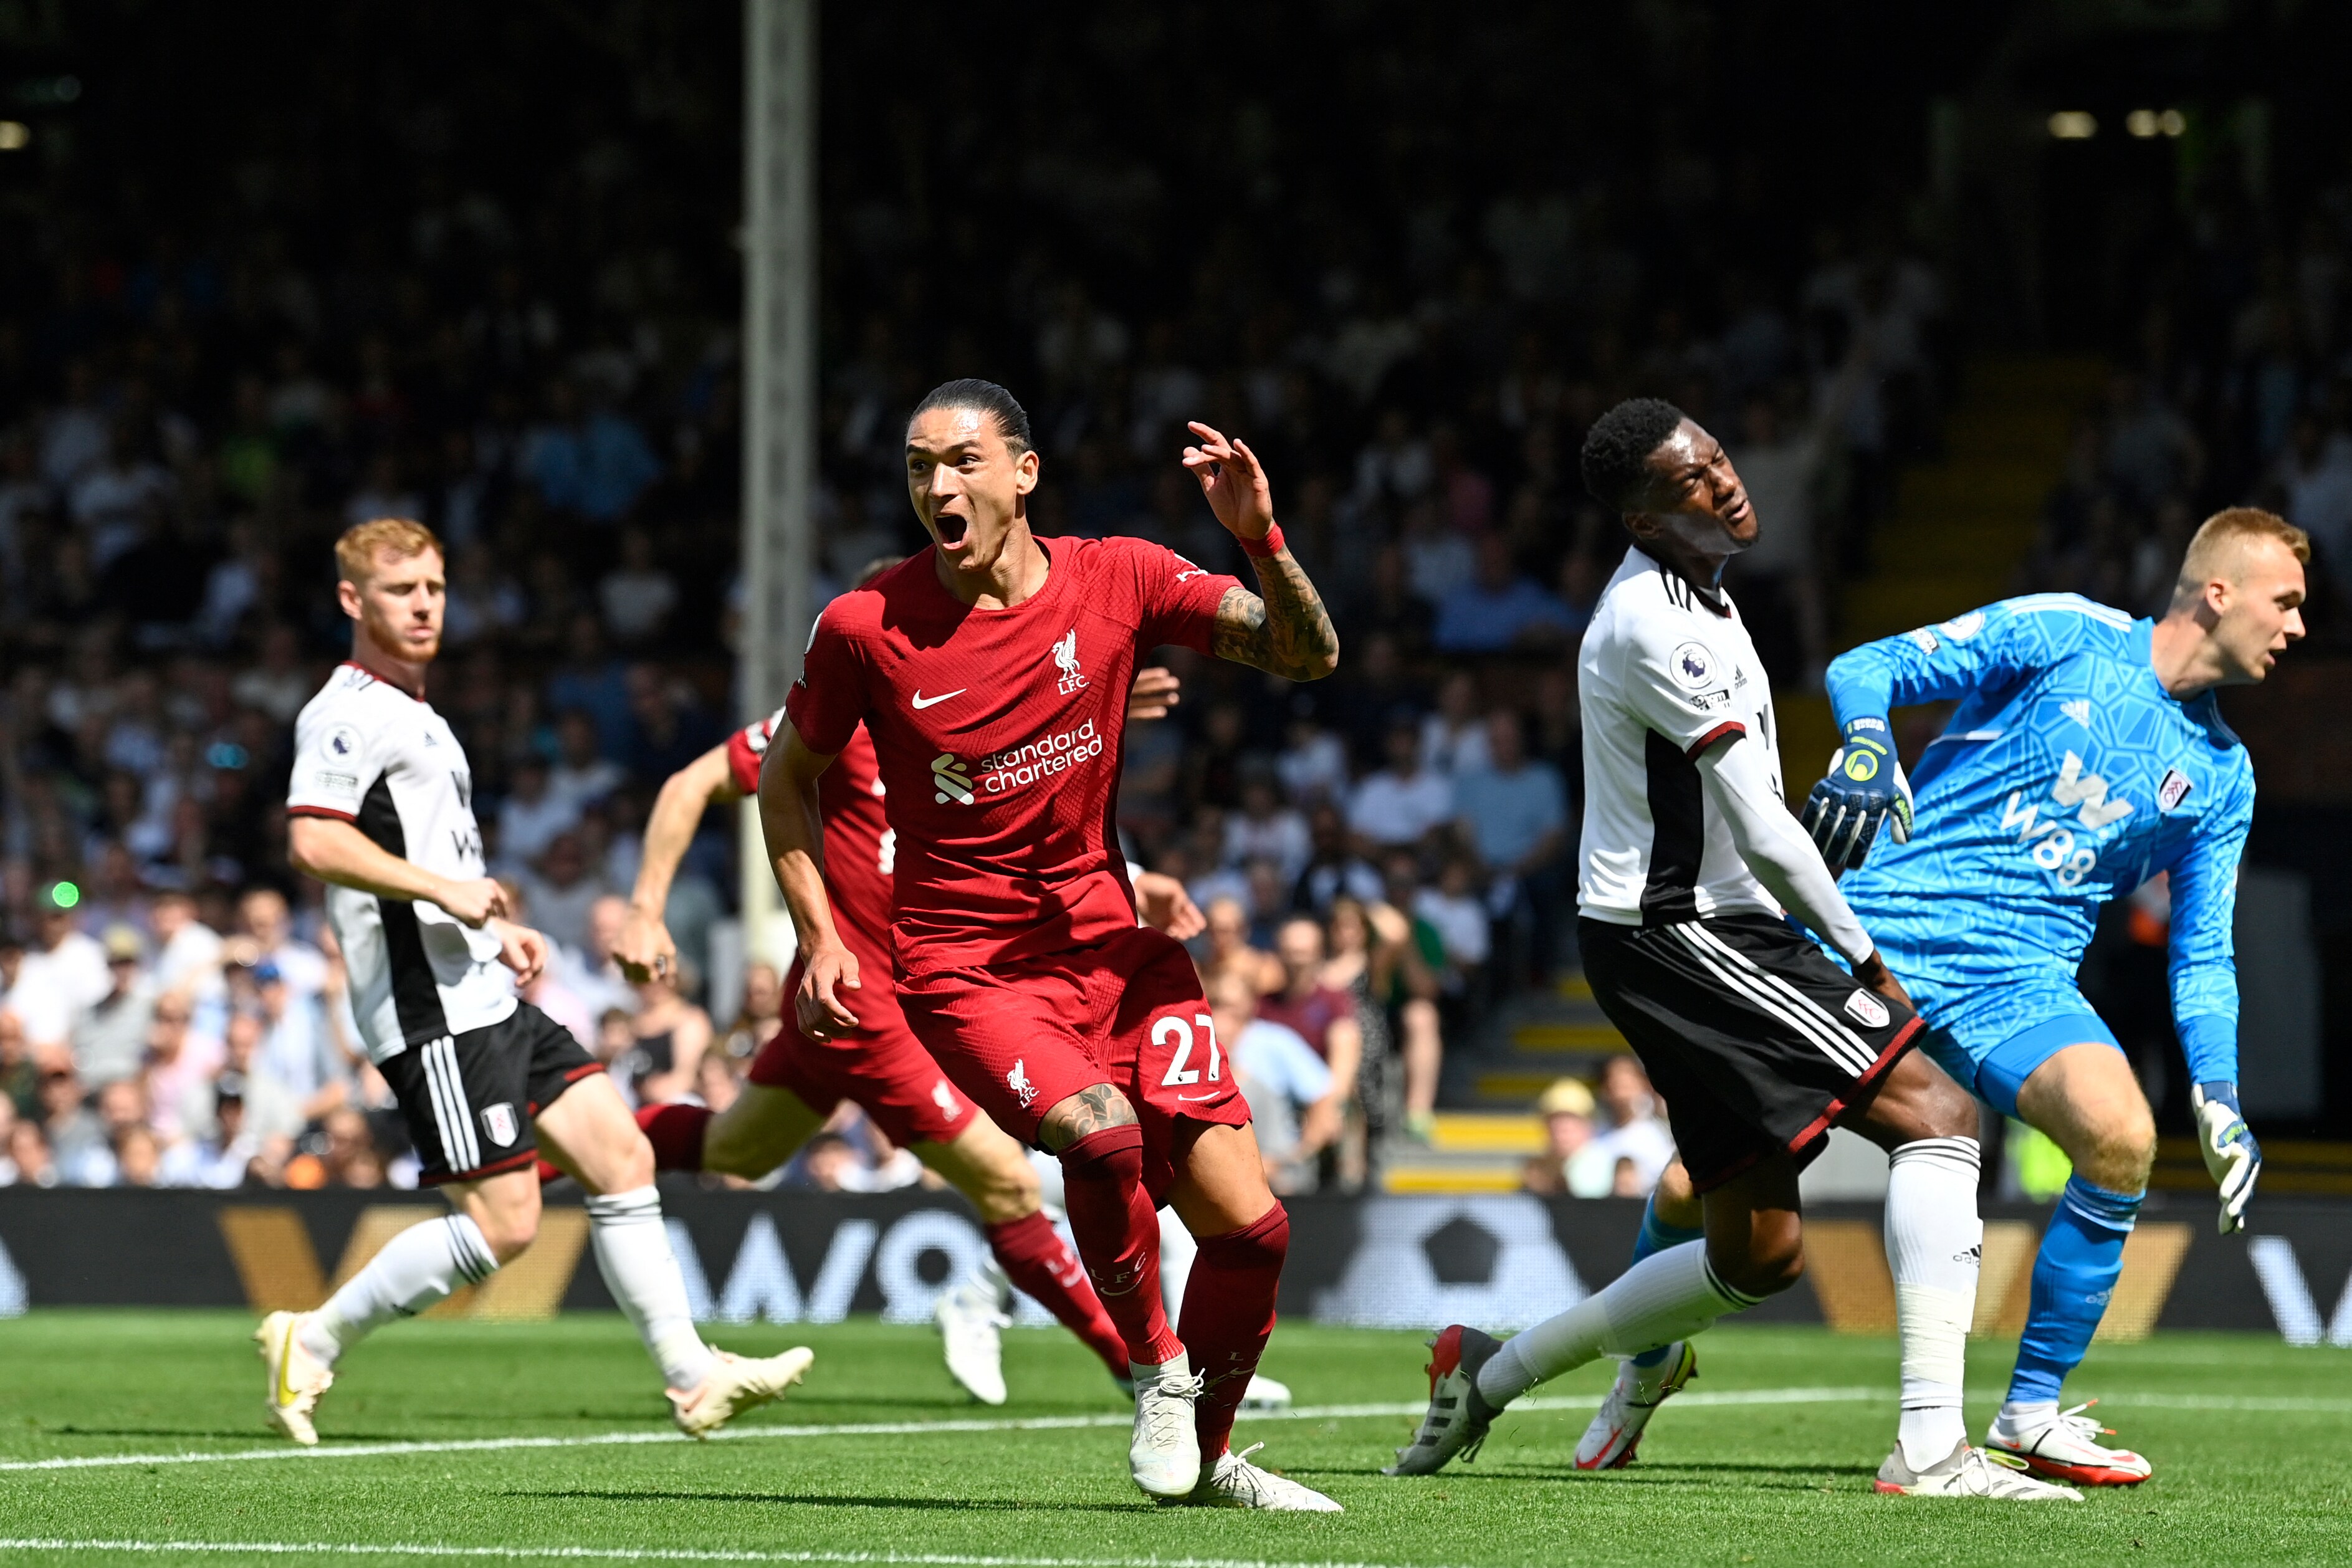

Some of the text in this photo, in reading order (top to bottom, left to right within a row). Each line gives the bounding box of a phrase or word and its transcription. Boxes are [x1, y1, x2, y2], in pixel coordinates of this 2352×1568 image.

[981, 718, 1094, 773] standard
[985, 734, 1102, 793] chartered
[2000, 791, 2096, 887] W88
[1858, 999, 1881, 1020] FFC
[1151, 1013, 1220, 1086] 27
